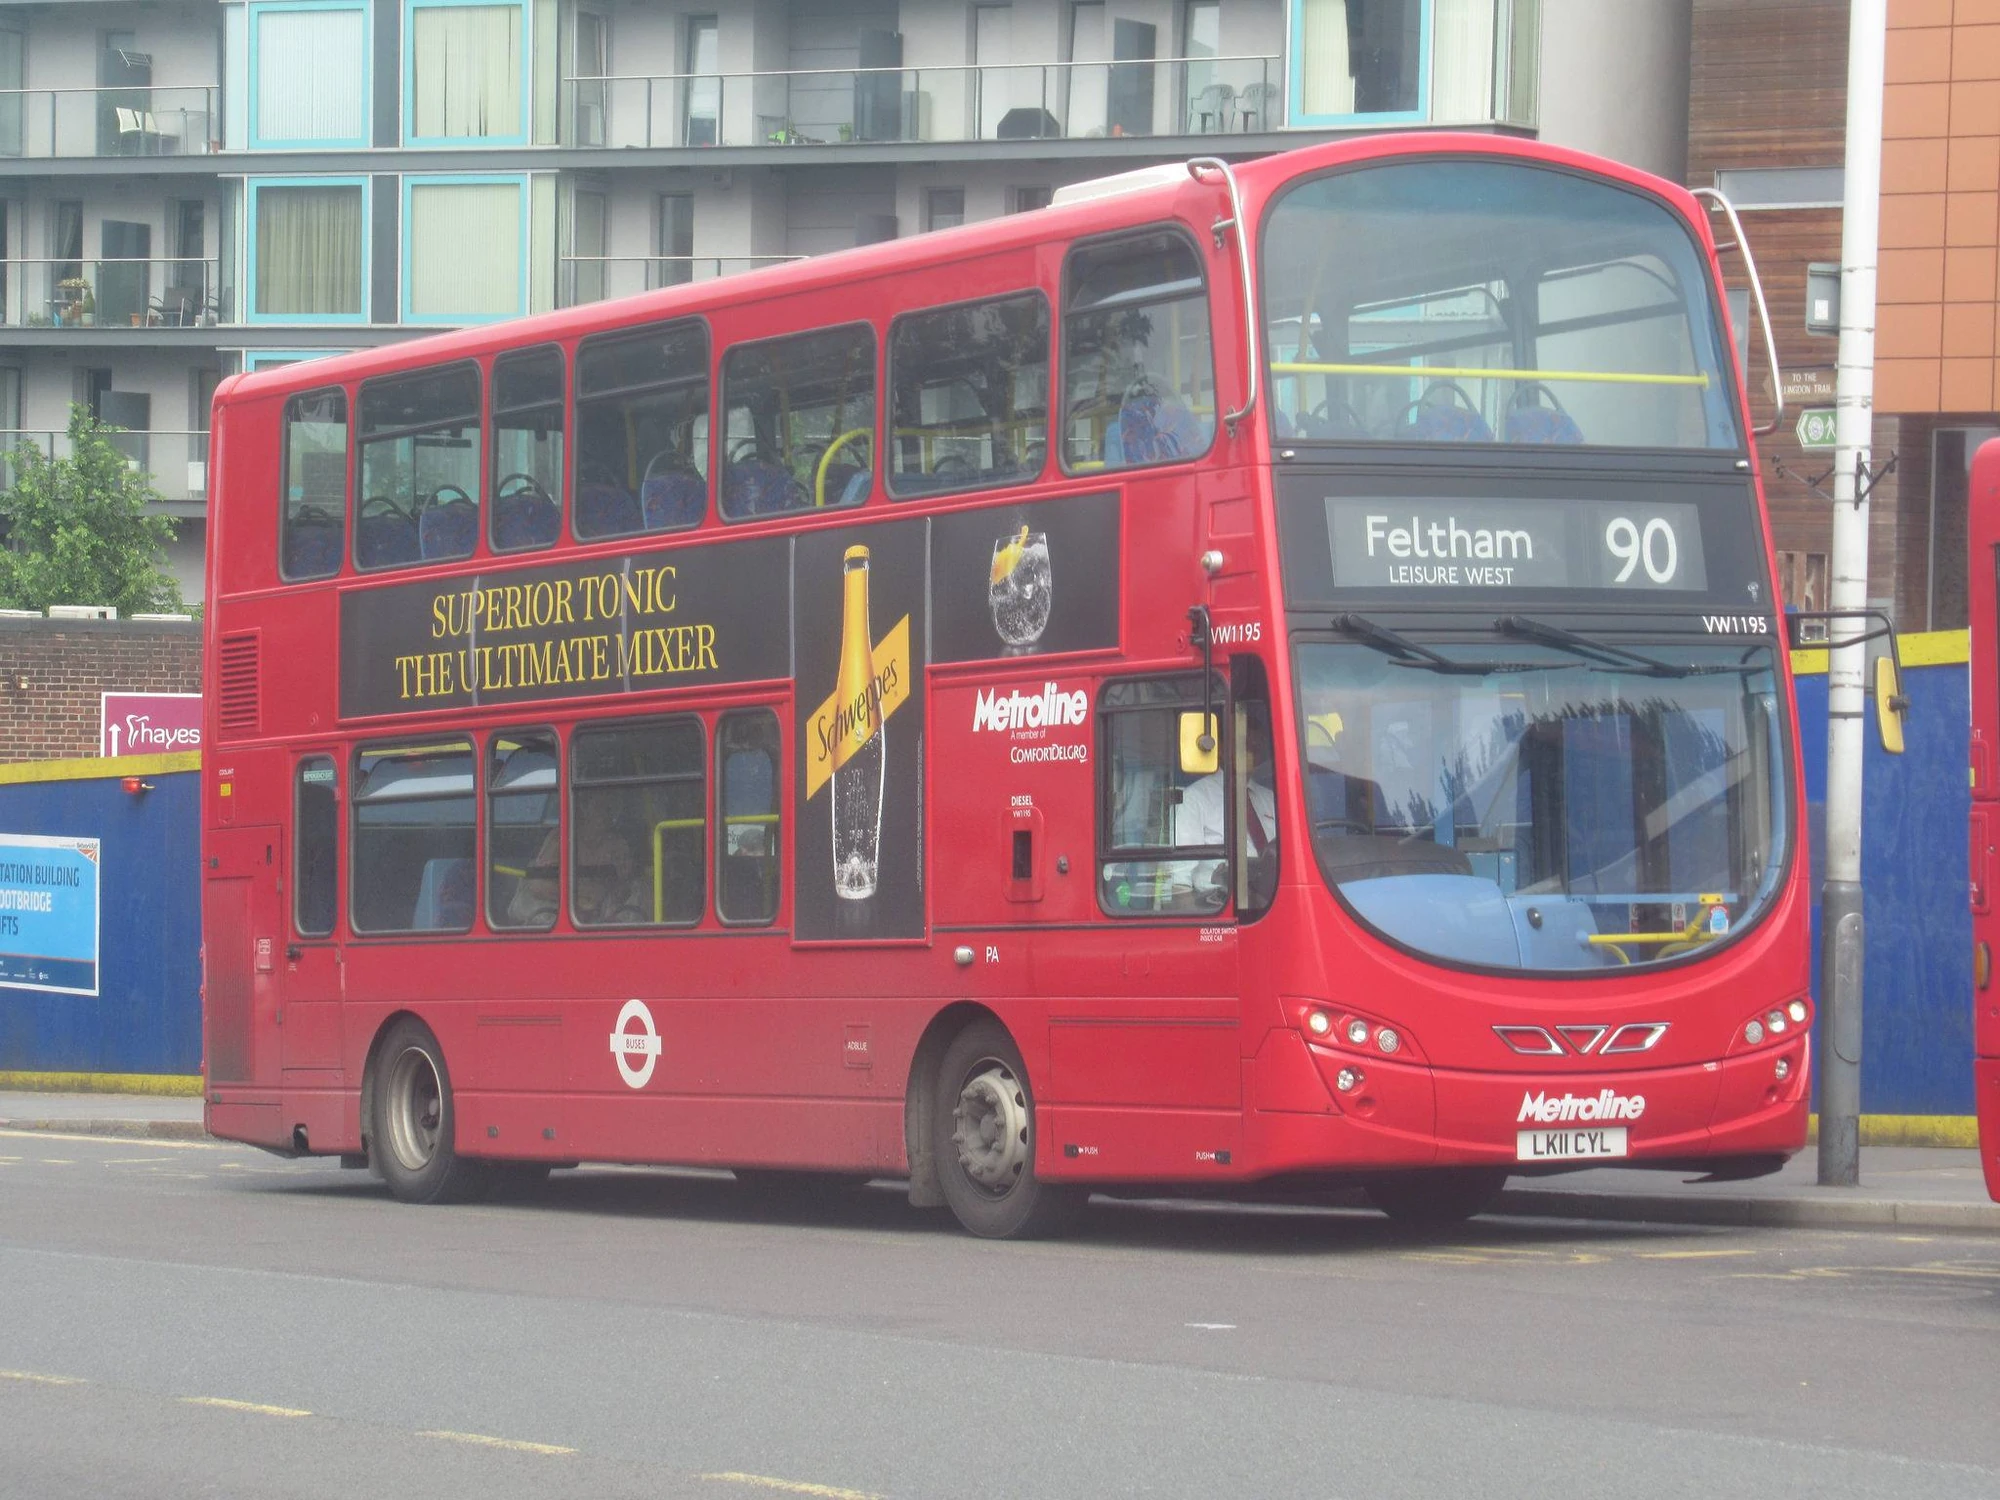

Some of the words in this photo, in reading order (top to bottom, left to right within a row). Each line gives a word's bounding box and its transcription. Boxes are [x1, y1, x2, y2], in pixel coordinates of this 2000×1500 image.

[1792, 372, 1801, 382] TO
[1803, 372, 1817, 382] THE
[1365, 515, 1534, 560] Feltham
[1605, 516, 1678, 584] 90
[1389, 564, 1459, 585] LEISURE
[1465, 566, 1515, 586] WEST
[431, 578, 575, 639] SUPERIOR
[578, 566, 677, 621] TONIC
[1210, 621, 1261, 645] VW1195
[1702, 615, 1768, 634] VW1195
[395, 652, 455, 699] THE
[457, 635, 610, 693] ULTIMATE
[615, 624, 719, 679] MIXER
[818, 658, 898, 762] Schweppes
[972, 682, 1088, 733] Metroline
[141, 721, 201, 749] hayes
[1016, 729, 1039, 740] member
[1011, 795, 1033, 807] DIESEL
[0, 863, 33, 885] TATION
[35, 865, 80, 888] BUILDING
[0, 888, 52, 913] OOTBRIDGE
[985, 946, 1000, 963] PA
[625, 1038, 646, 1050] BUSES
[1516, 1088, 1646, 1123] Metroline
[1084, 1146, 1099, 1155] PUSH
[1195, 1151, 1210, 1160] PUSH
[1532, 1134, 1569, 1156] LK11
[1574, 1131, 1611, 1154] CYL
